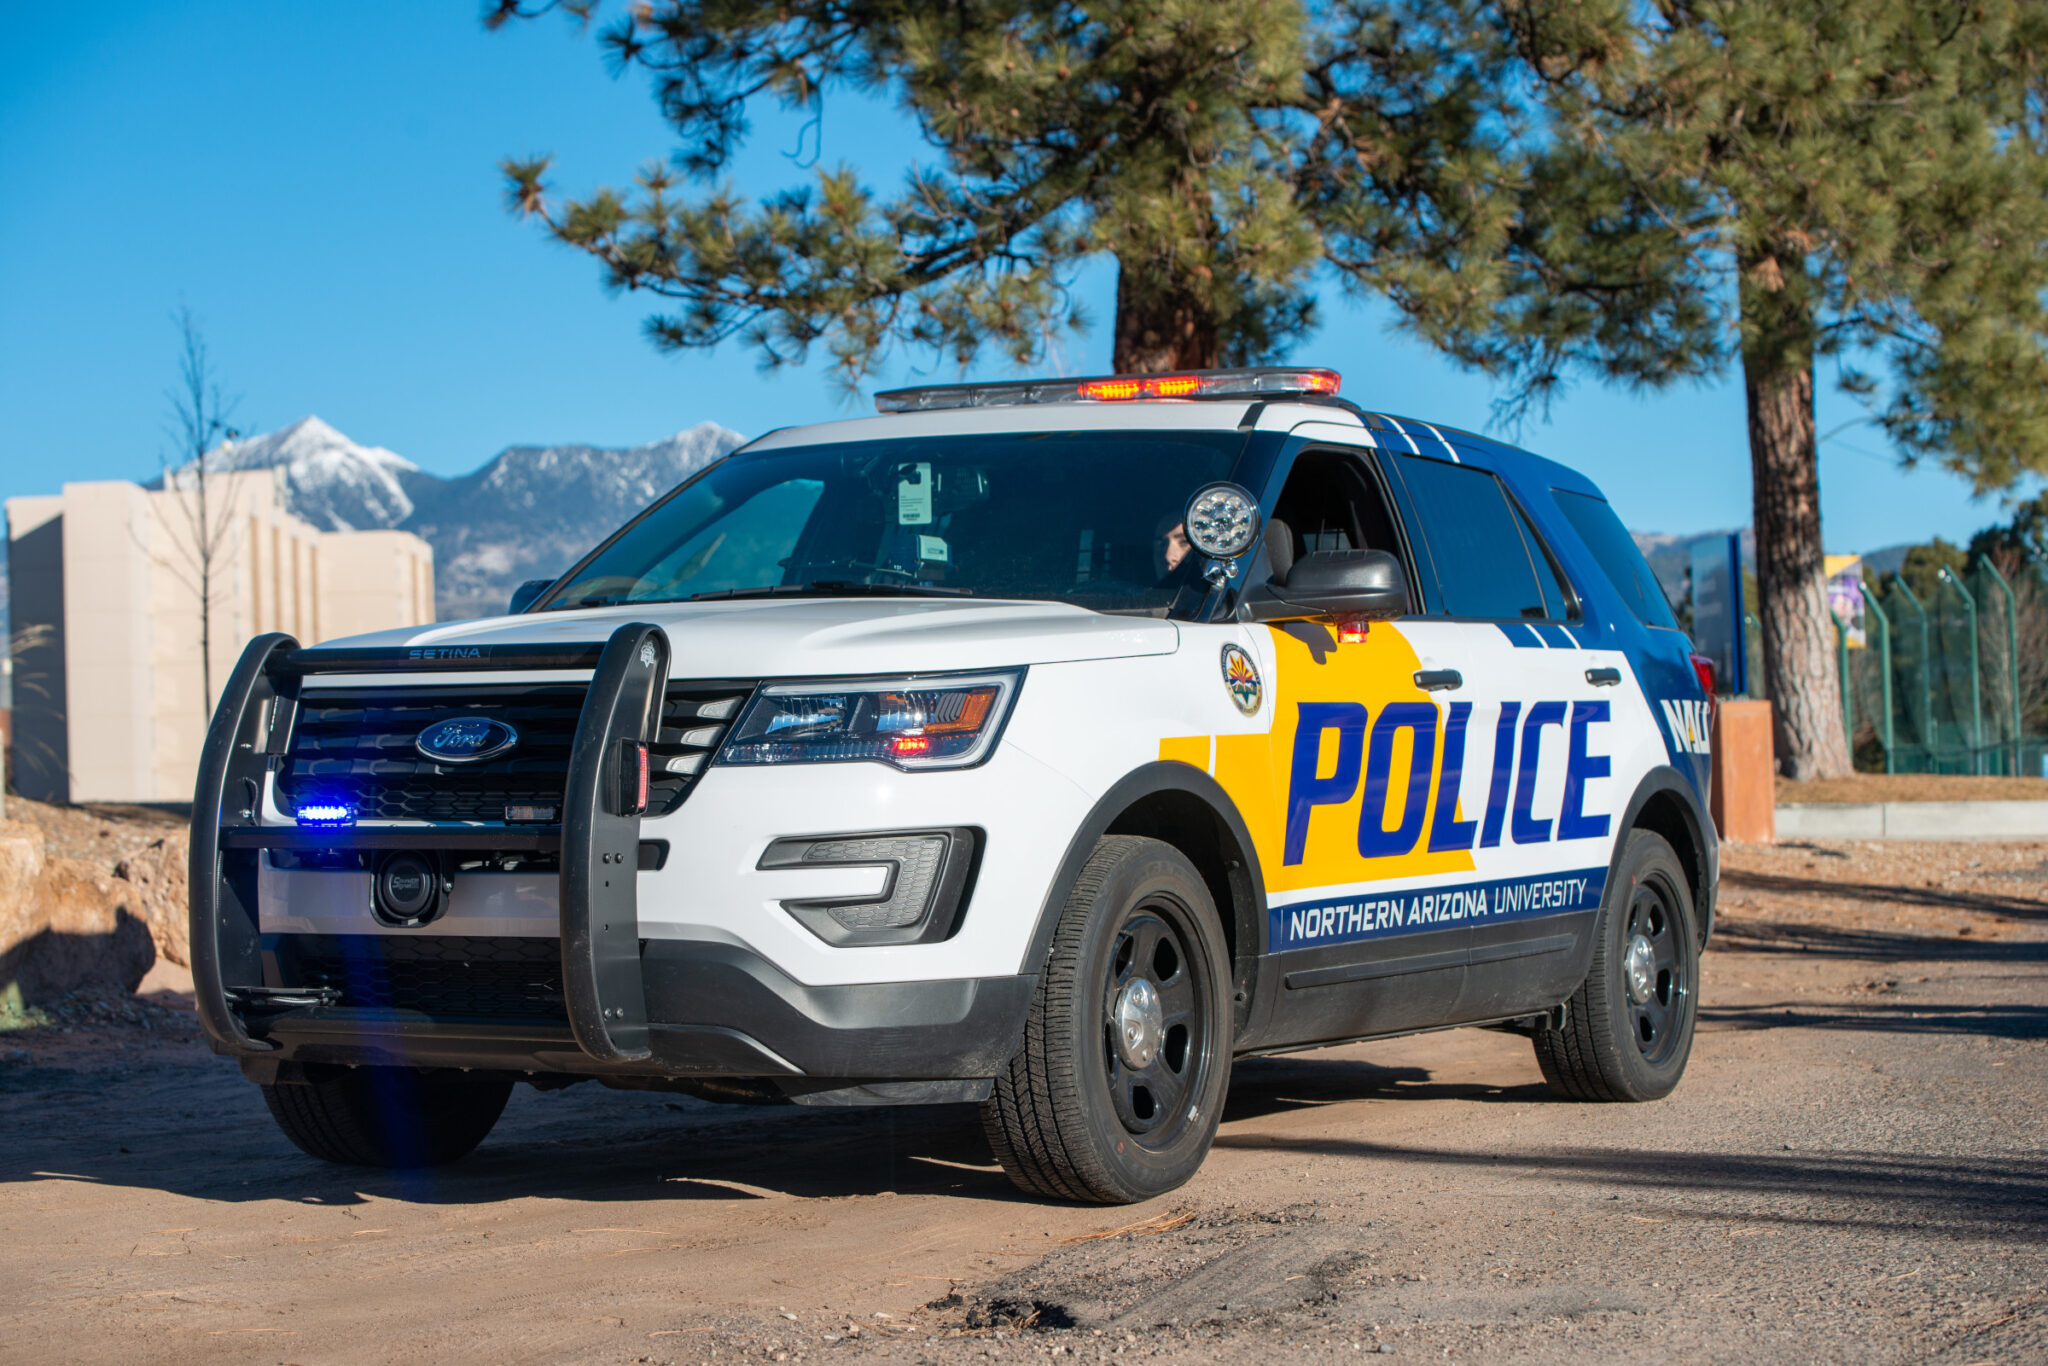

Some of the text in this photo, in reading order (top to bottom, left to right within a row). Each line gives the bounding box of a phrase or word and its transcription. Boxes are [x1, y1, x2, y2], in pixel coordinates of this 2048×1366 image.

[409, 647, 481, 660] SETINA
[1659, 699, 1711, 753] NAU
[1283, 700, 1611, 867] POLICE
[1290, 878, 1588, 941] NORTHERN ARIZONA UNIVERSITY
